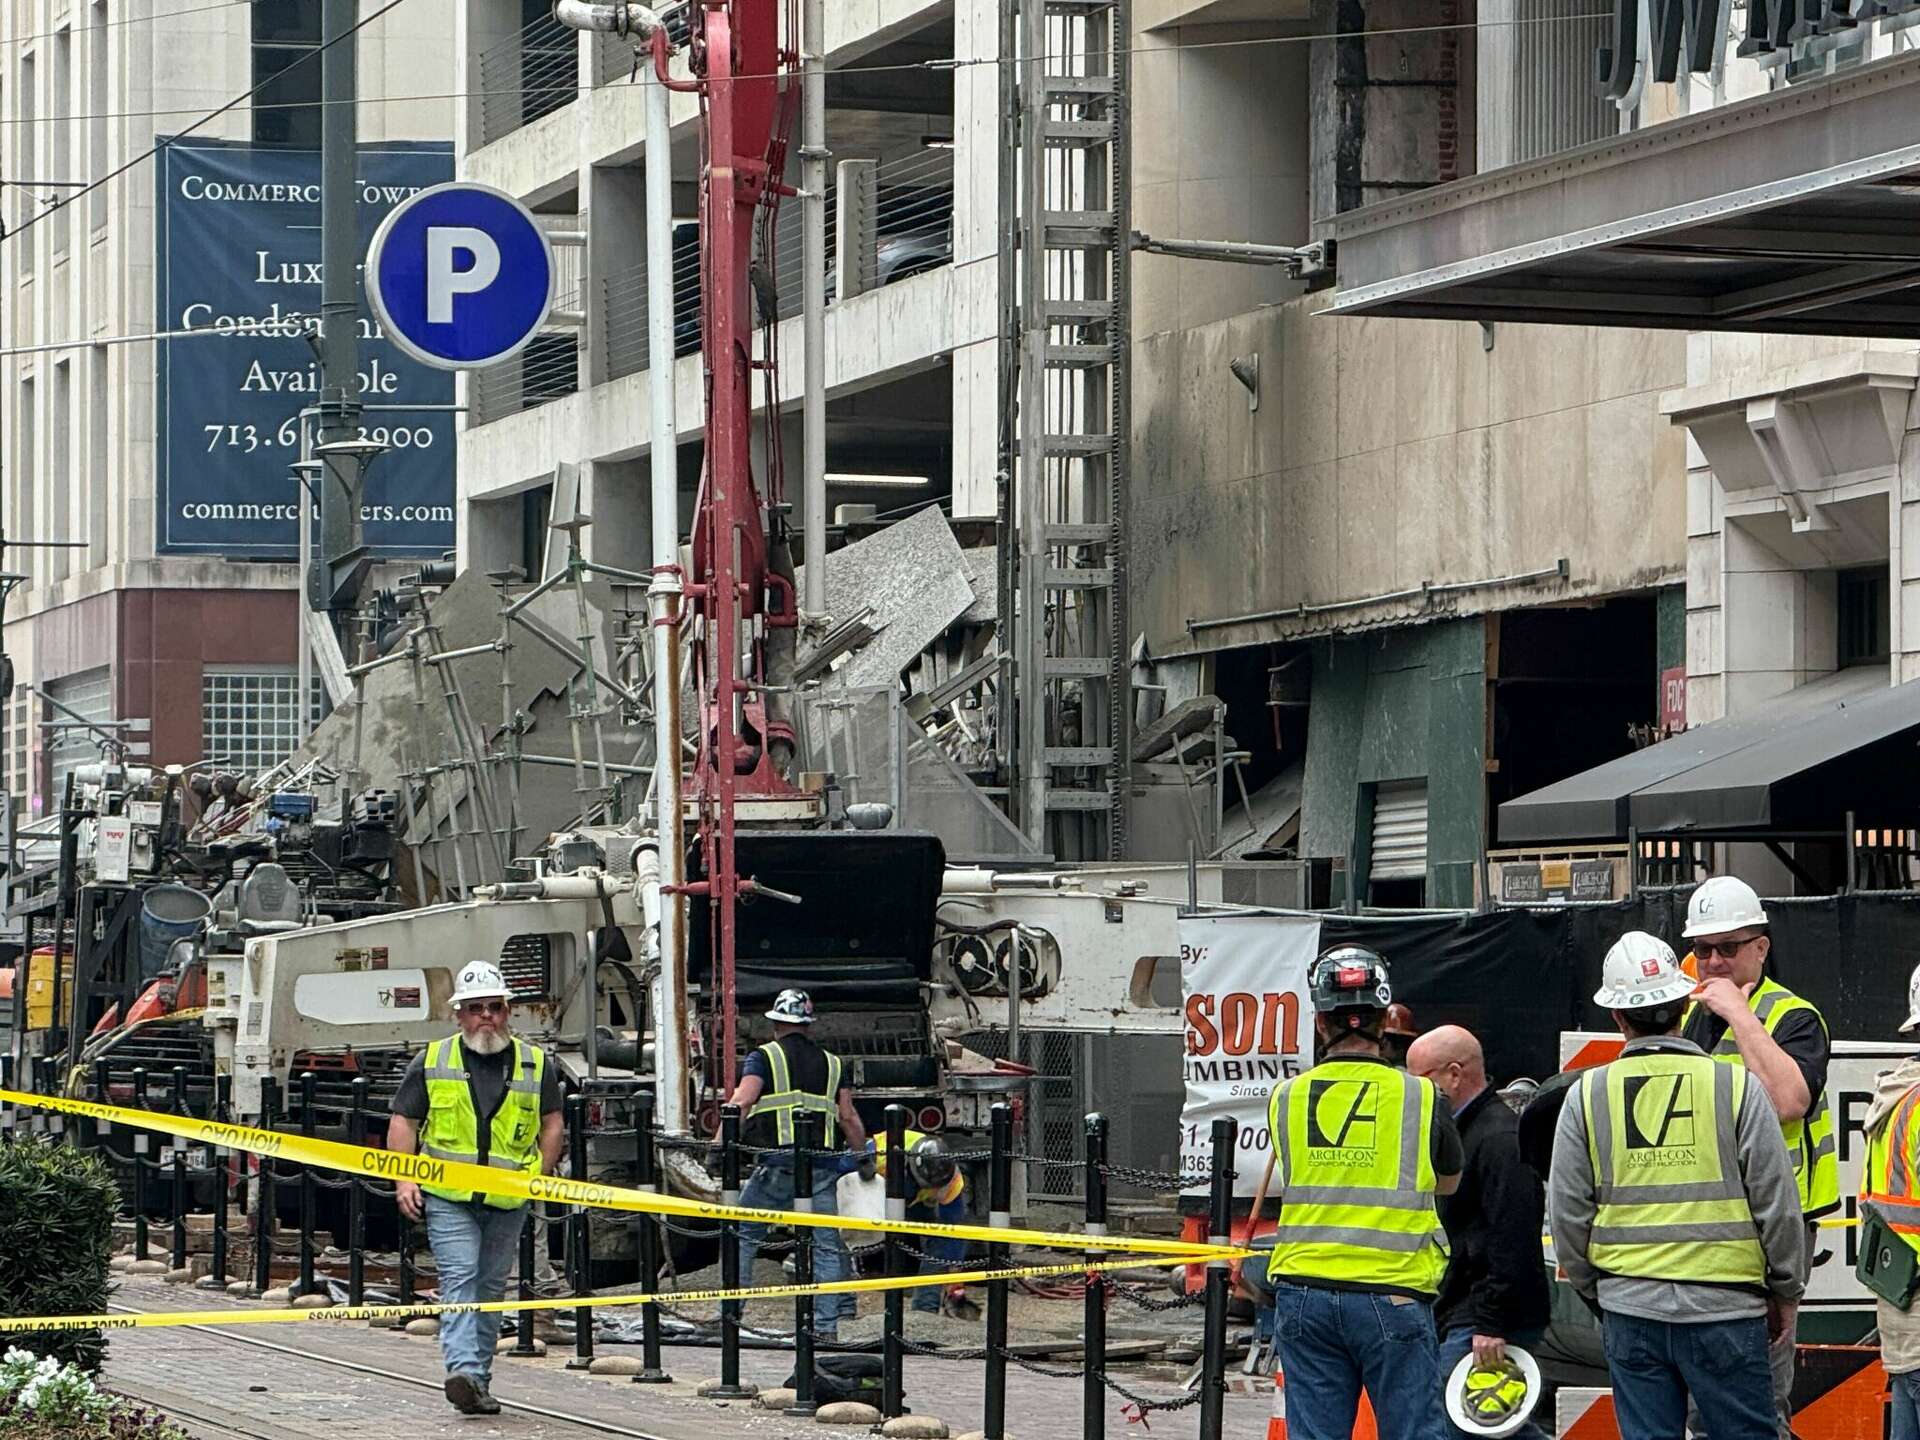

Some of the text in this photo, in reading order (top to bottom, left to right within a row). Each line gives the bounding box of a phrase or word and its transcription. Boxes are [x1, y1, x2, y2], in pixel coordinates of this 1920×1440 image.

[181, 176, 320, 202] COMMERC
[427, 226, 500, 323] P
[1667, 679, 1684, 712] FDC
[1230, 1084, 1268, 1097] Since
